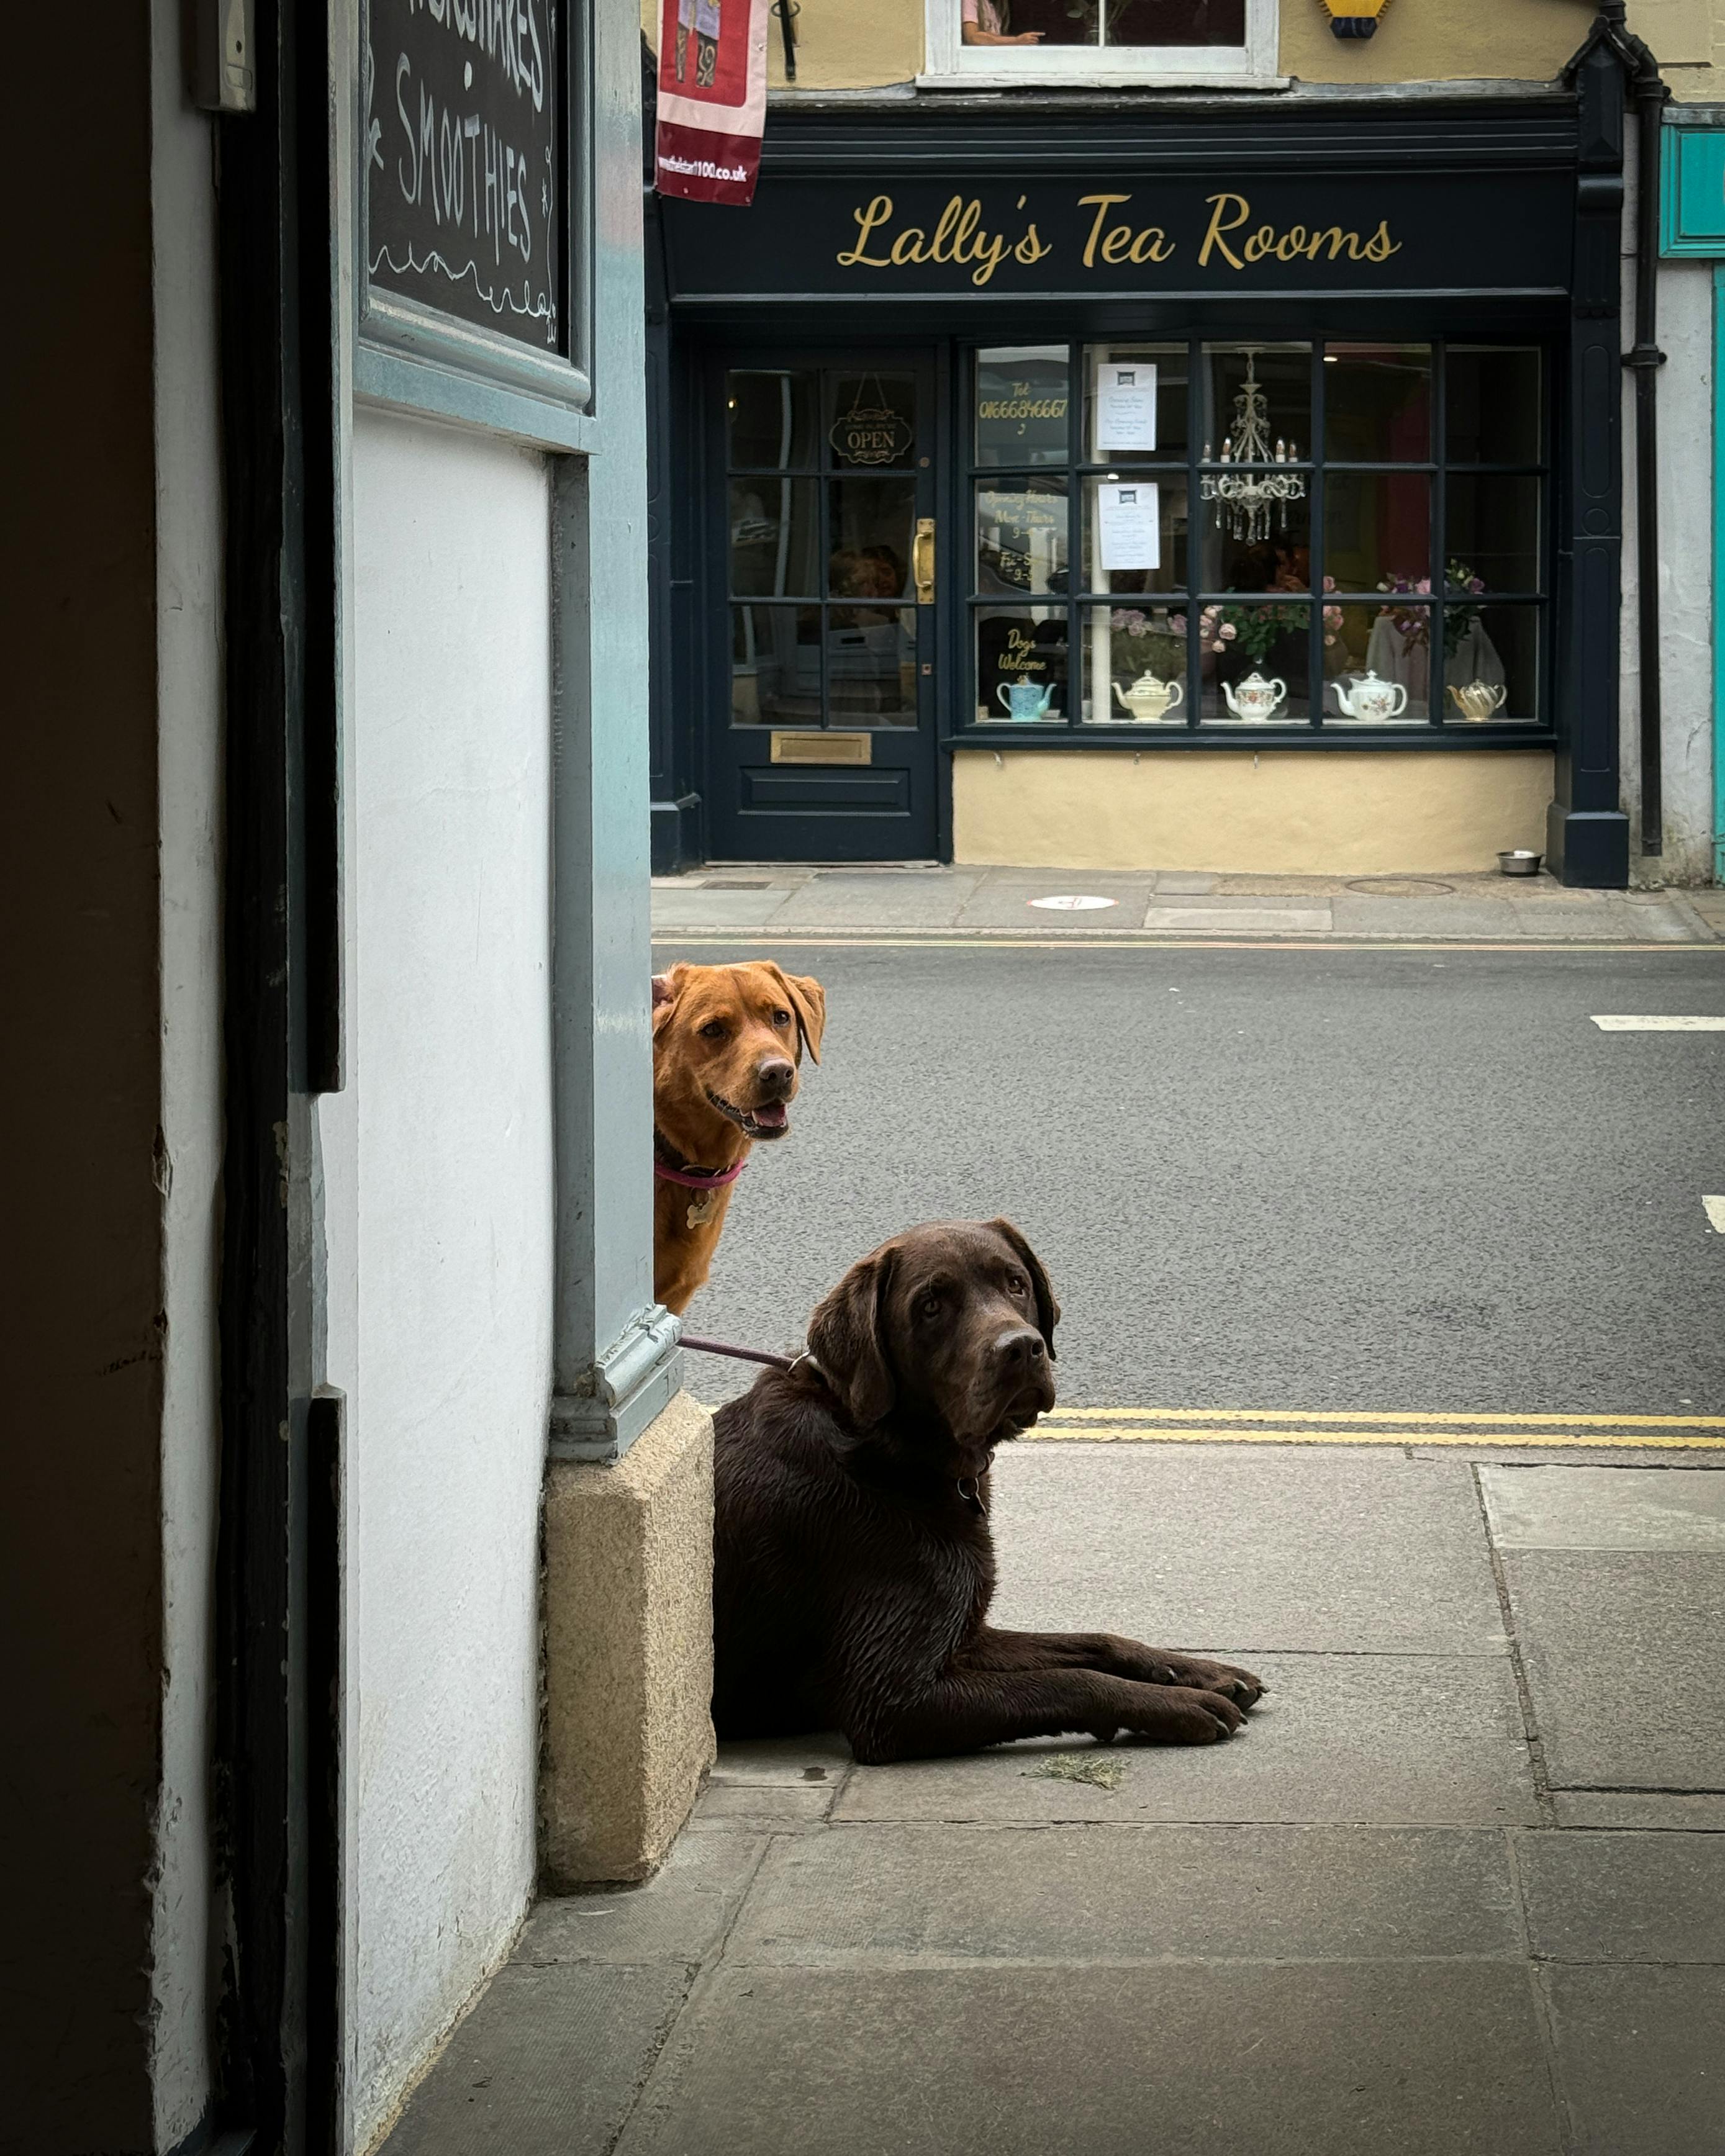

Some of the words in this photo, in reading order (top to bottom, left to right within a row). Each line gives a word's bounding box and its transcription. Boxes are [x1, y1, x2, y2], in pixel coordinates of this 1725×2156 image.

[410, 0, 543, 113] HAKES
[396, 52, 531, 266] SMOOTHIES
[836, 194, 1053, 286] Lally's
[1077, 194, 1175, 268] Tea
[1198, 194, 1403, 270] Rooms
[847, 431, 895, 449] OPEN
[998, 652, 1047, 670] Welcome
[1007, 628, 1036, 657] Dogs
